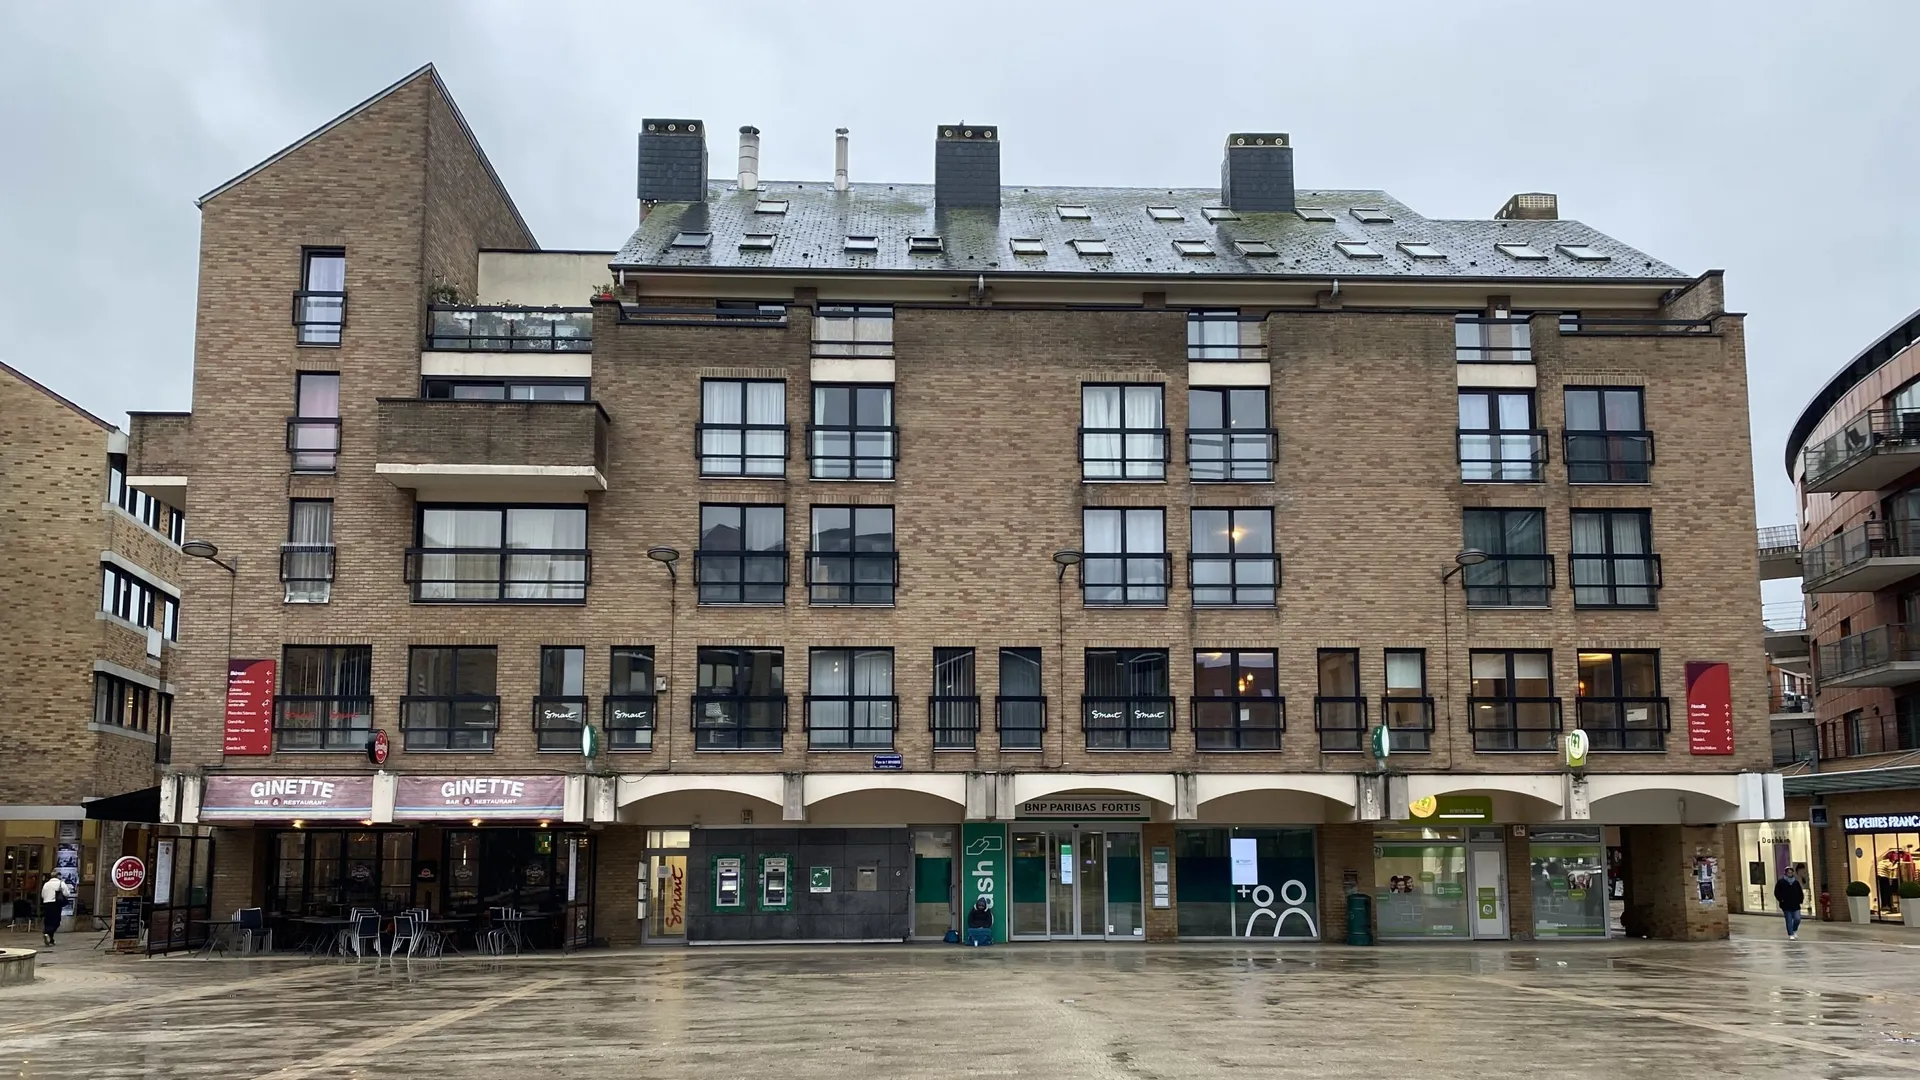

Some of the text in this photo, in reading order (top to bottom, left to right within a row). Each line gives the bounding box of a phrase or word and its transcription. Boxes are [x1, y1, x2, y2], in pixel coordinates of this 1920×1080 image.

[544, 710, 579, 719] Smart
[614, 710, 646, 719] Smart
[1092, 710, 1165, 719] Smart Smart
[251, 779, 334, 798] GINETTE
[441, 779, 524, 797] GINETTE
[1025, 803, 1140, 811] BNP PARIBAS FORTIS
[1845, 818, 1859, 829] LES
[1860, 817, 1887, 828] PETITES
[116, 868, 143, 879] Ginette
[666, 864, 683, 927] Smart
[972, 861, 994, 924] ash
